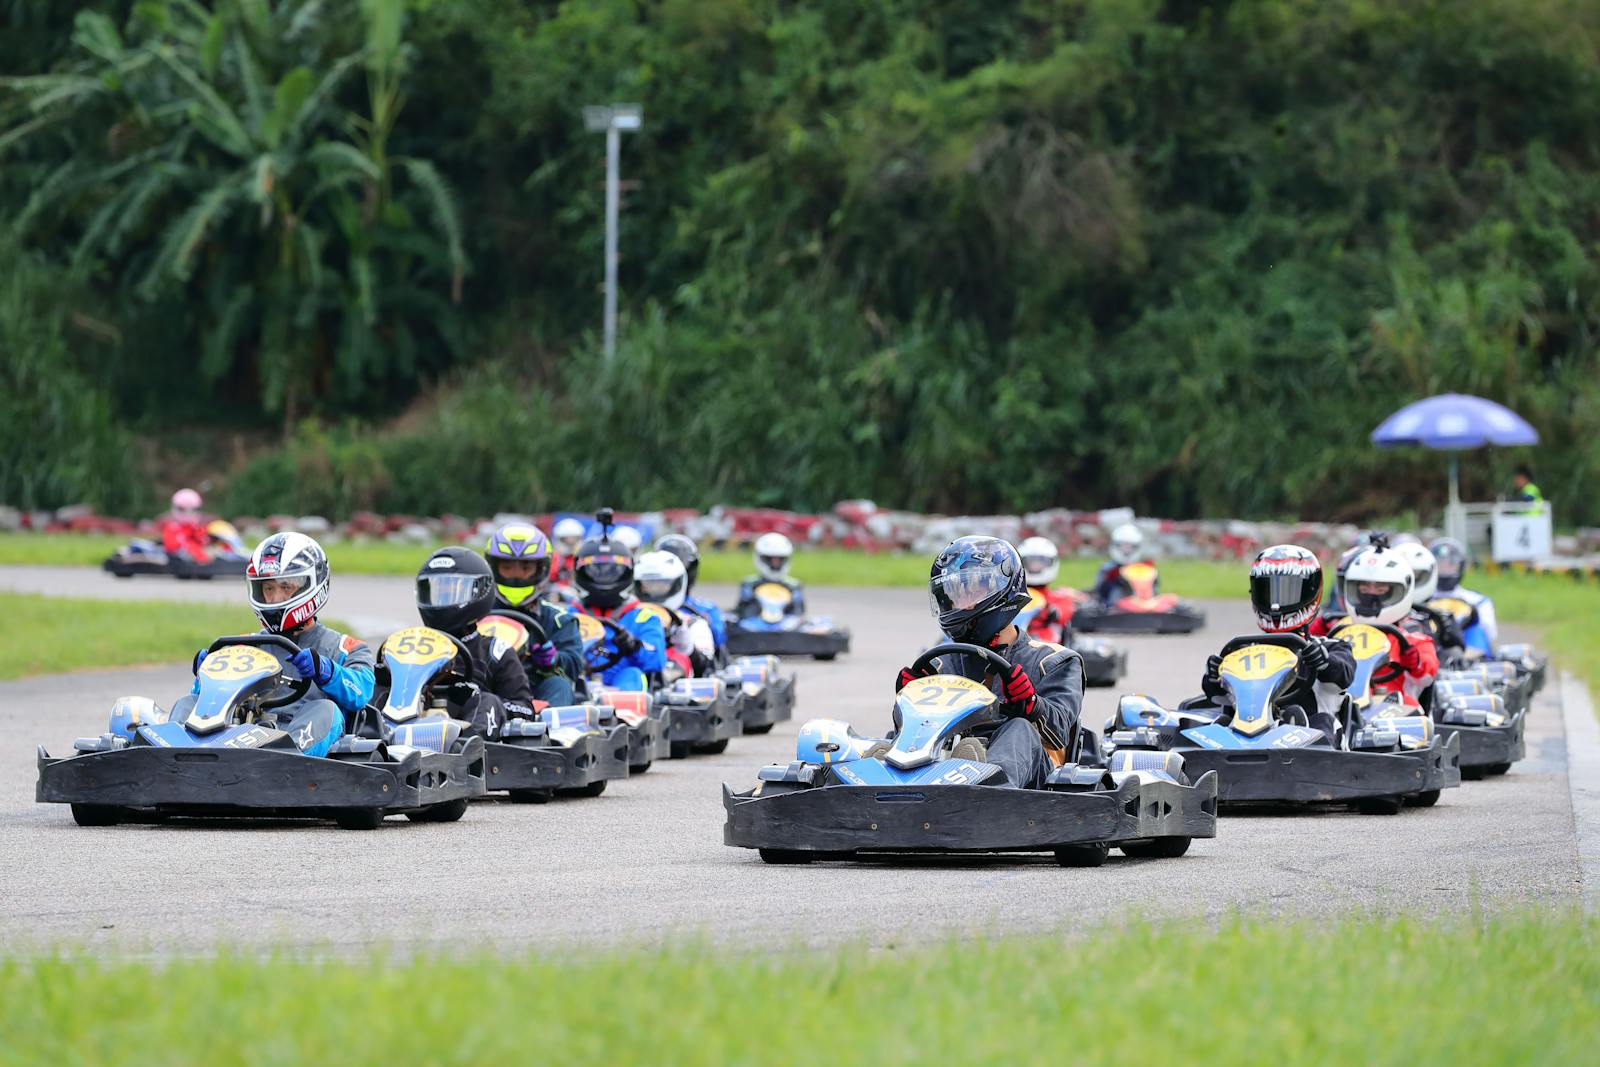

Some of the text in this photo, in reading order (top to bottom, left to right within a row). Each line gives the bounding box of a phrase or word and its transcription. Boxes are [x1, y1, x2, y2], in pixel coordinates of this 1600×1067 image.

[292, 599, 315, 623] WILD
[396, 636, 436, 656] 55
[207, 654, 256, 673] 53
[1239, 652, 1266, 673] 11
[914, 686, 971, 707] 27
